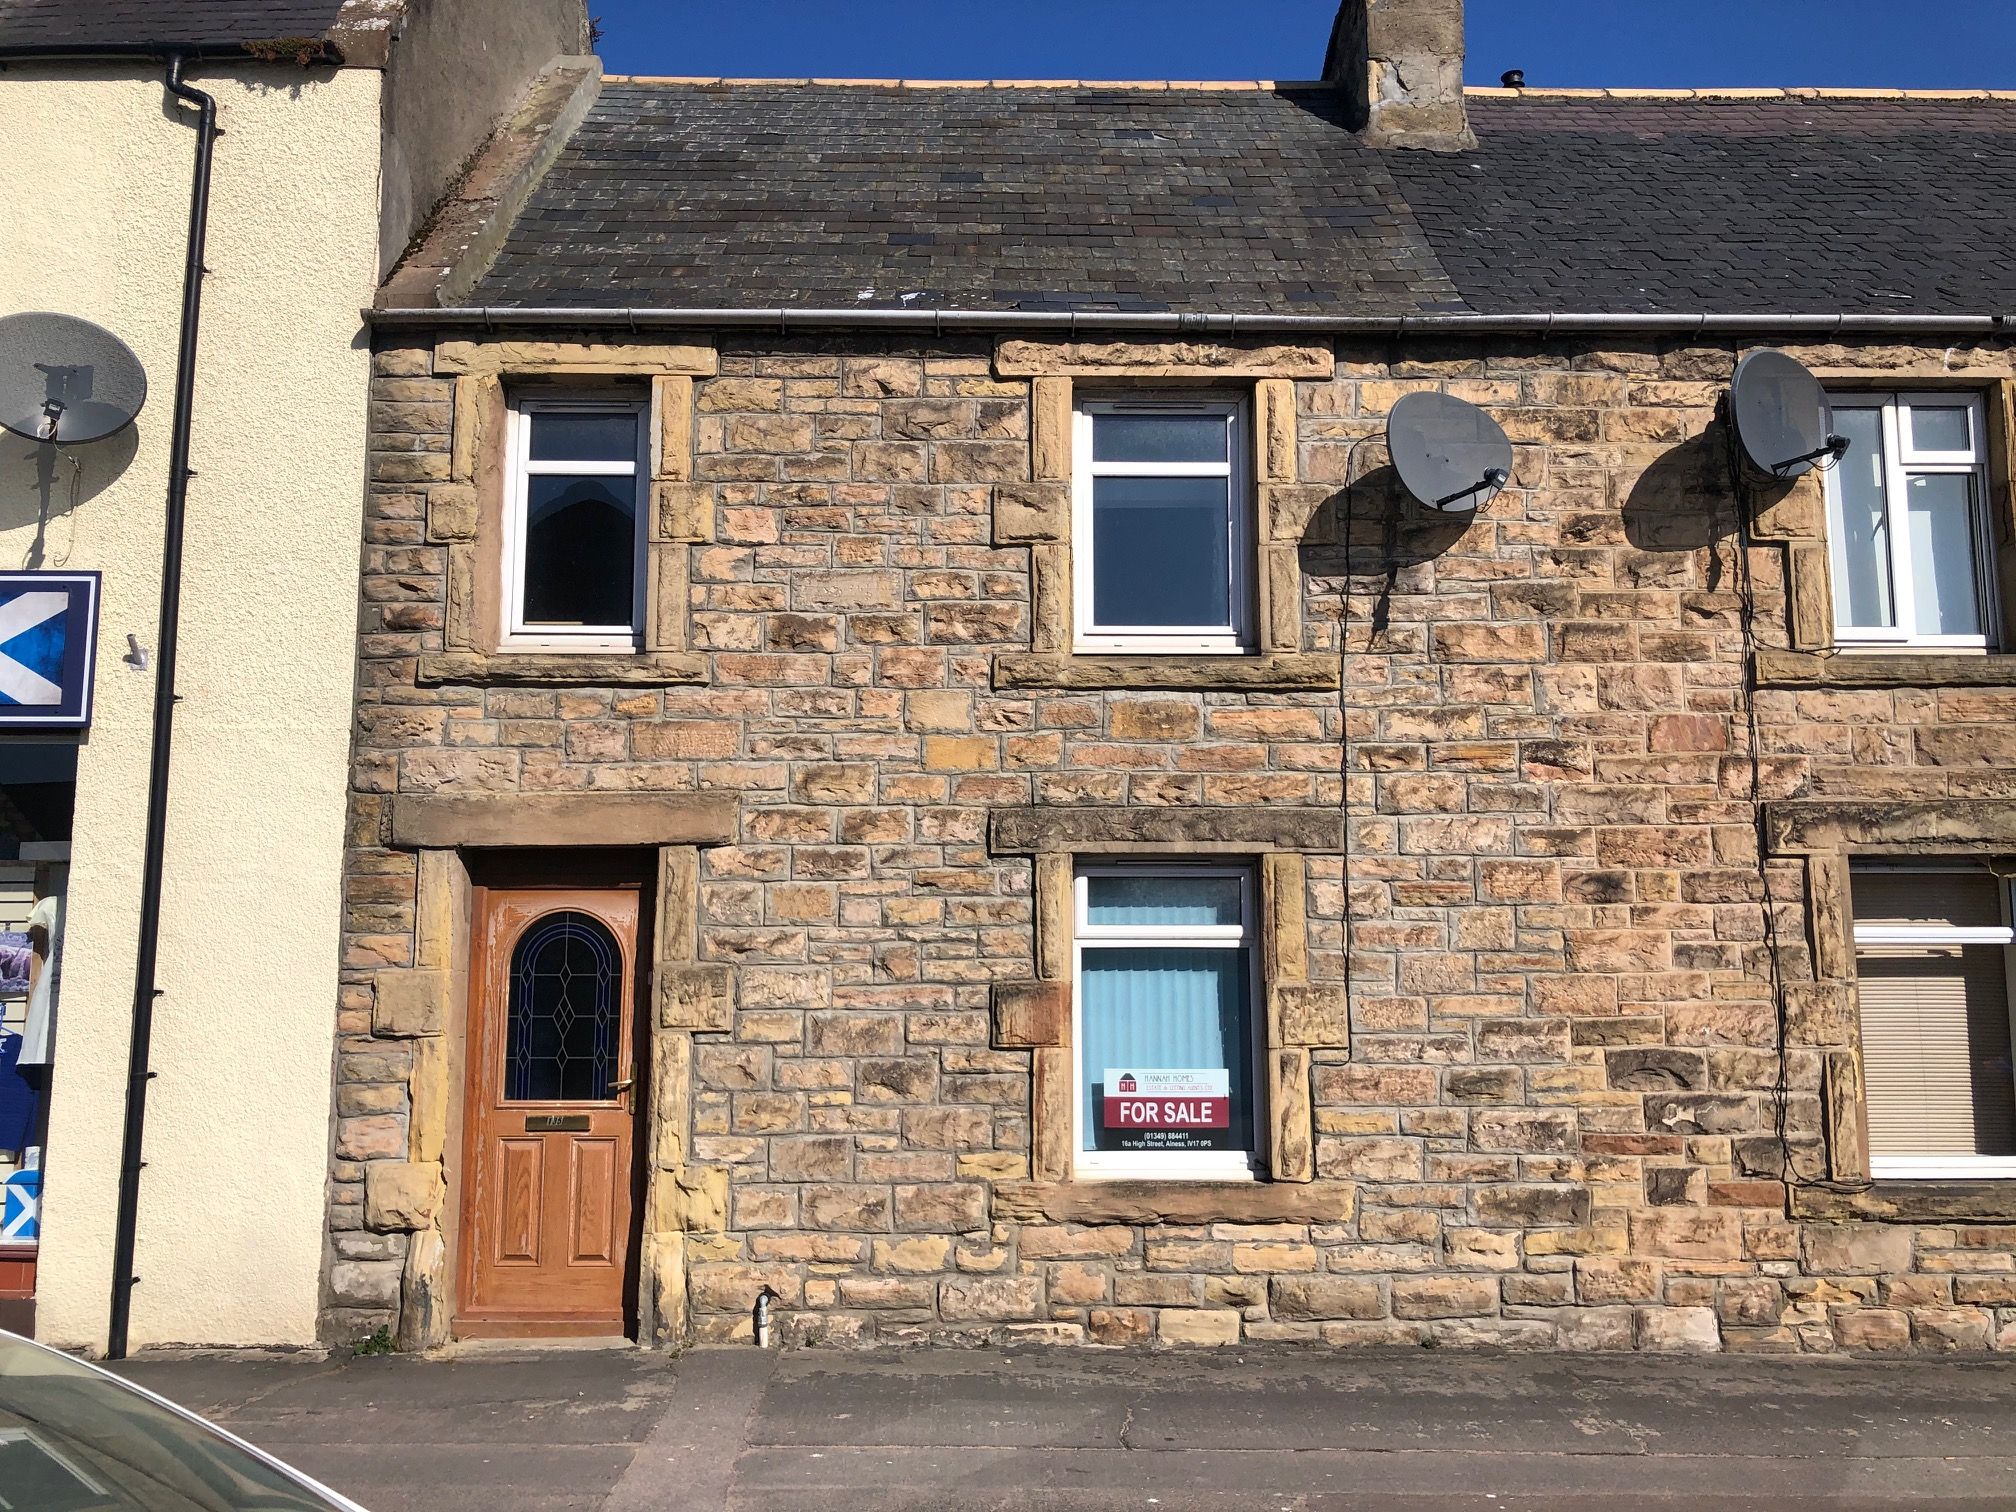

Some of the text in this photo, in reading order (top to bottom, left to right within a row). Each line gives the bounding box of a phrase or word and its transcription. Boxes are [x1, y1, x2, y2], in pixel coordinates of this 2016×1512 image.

[1173, 1074, 1194, 1083] HOMES
[1120, 1102, 1212, 1122] FOR SALE
[1144, 1132, 1167, 1141] (01349)
[1132, 1140, 1146, 1148] High
